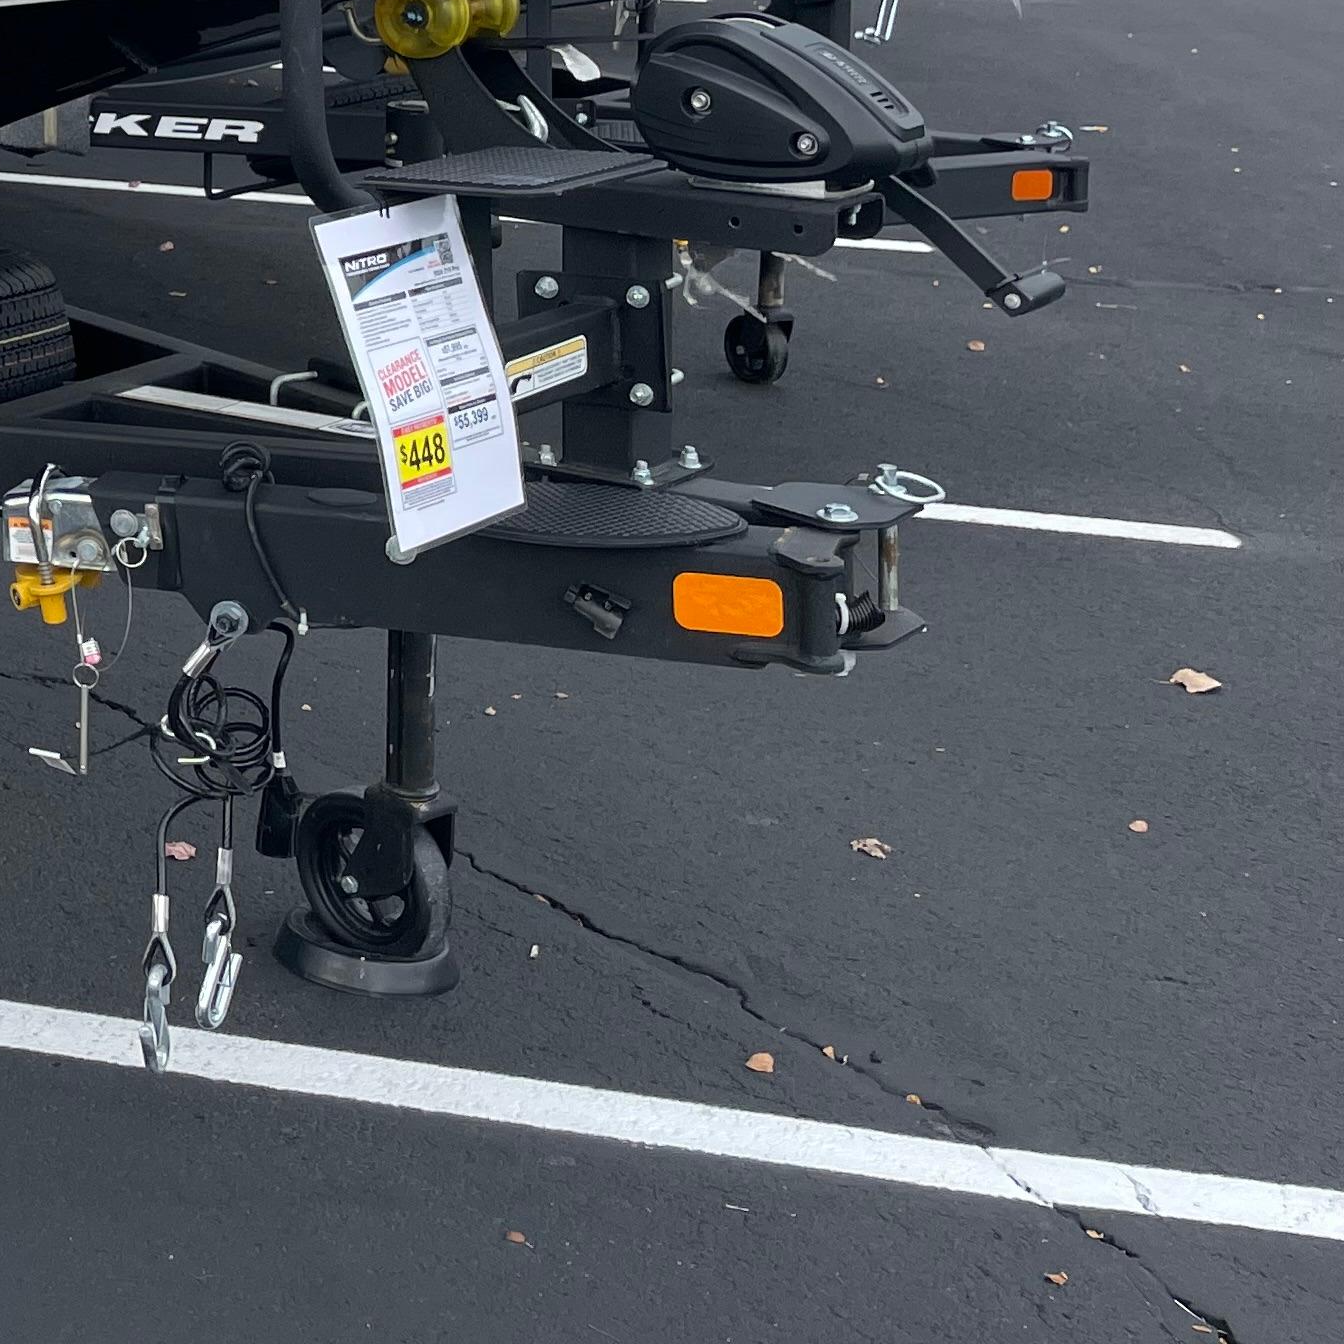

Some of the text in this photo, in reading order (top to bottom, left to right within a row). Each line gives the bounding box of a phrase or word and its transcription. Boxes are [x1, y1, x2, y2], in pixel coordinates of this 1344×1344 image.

[89, 112, 265, 144] KER
[344, 253, 388, 274] NITRO
[377, 348, 422, 381] CLEARANCE
[383, 360, 430, 399] MODEL!
[389, 391, 416, 412] SAVE
[415, 378, 434, 400] BIG!
[399, 432, 446, 471] $448
